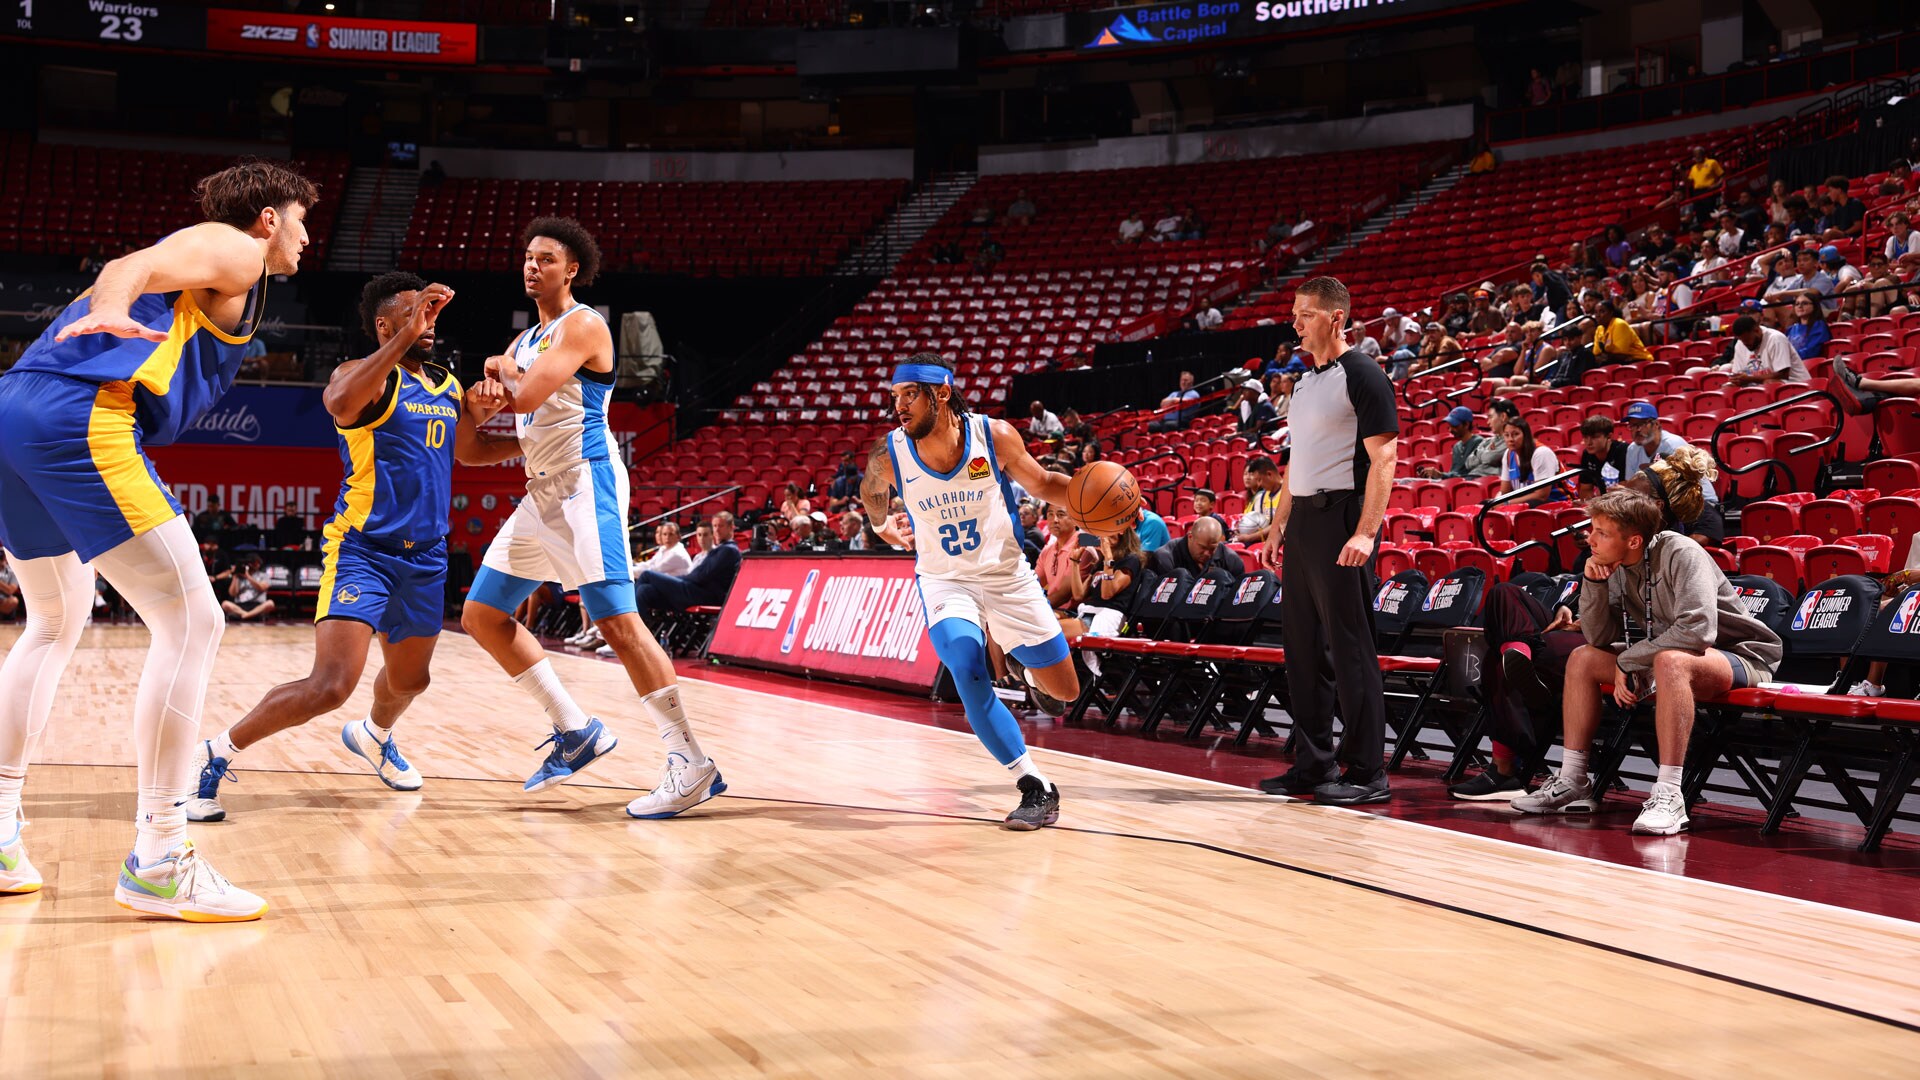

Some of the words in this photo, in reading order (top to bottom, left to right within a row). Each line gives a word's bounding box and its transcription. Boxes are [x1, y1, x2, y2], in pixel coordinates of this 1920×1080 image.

[89, 0, 159, 17] Warriors
[1137, 5, 1192, 25] Battle
[1197, 1, 1240, 18] Born
[1255, 0, 1368, 22] Southern
[17, 19, 32, 30] TOL
[100, 15, 143, 41] 23
[1163, 21, 1228, 42] Capital
[241, 25, 298, 41] 2K25
[329, 27, 388, 51] SUMMER
[391, 31, 441, 54] LEAGUE
[425, 418, 446, 449] 10
[918, 490, 984, 512] OKLAHOMA
[940, 505, 967, 520] CITY
[938, 518, 982, 556] 23
[1824, 589, 1846, 597] 2K25
[1816, 596, 1852, 613] SUMMER
[735, 587, 793, 630] 2K25
[803, 576, 884, 656] SUMMER
[1809, 612, 1841, 629] LEAGUE
